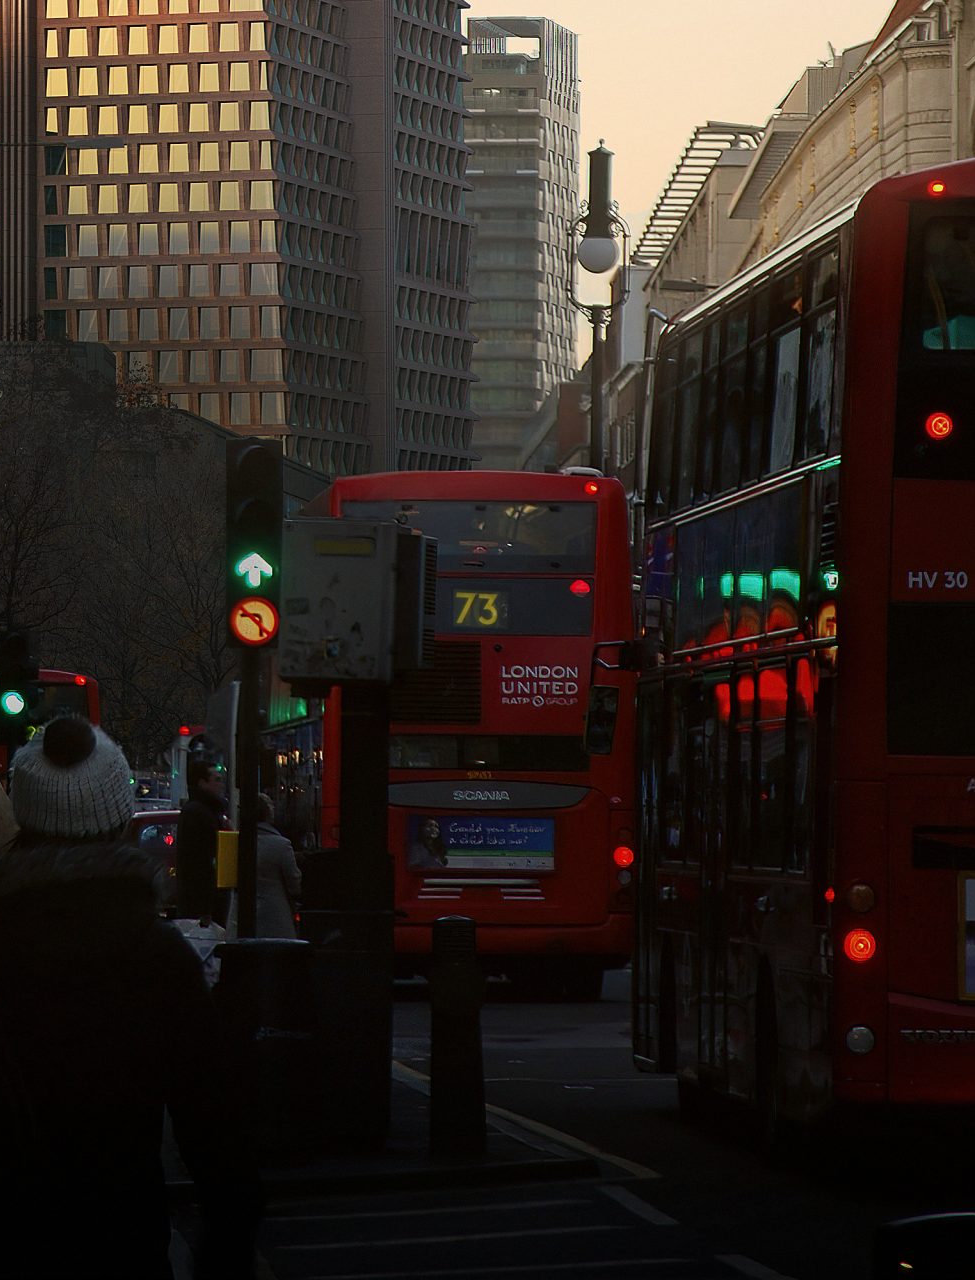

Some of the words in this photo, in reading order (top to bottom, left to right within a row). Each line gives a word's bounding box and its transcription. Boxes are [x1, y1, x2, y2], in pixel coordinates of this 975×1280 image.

[908, 571, 938, 589] HV
[944, 571, 968, 589] 30
[455, 591, 498, 625] 73
[501, 666, 578, 679] LONDON
[501, 682, 578, 695] UNITED
[501, 697, 530, 705] RATP
[452, 790, 510, 801] SCANIA
